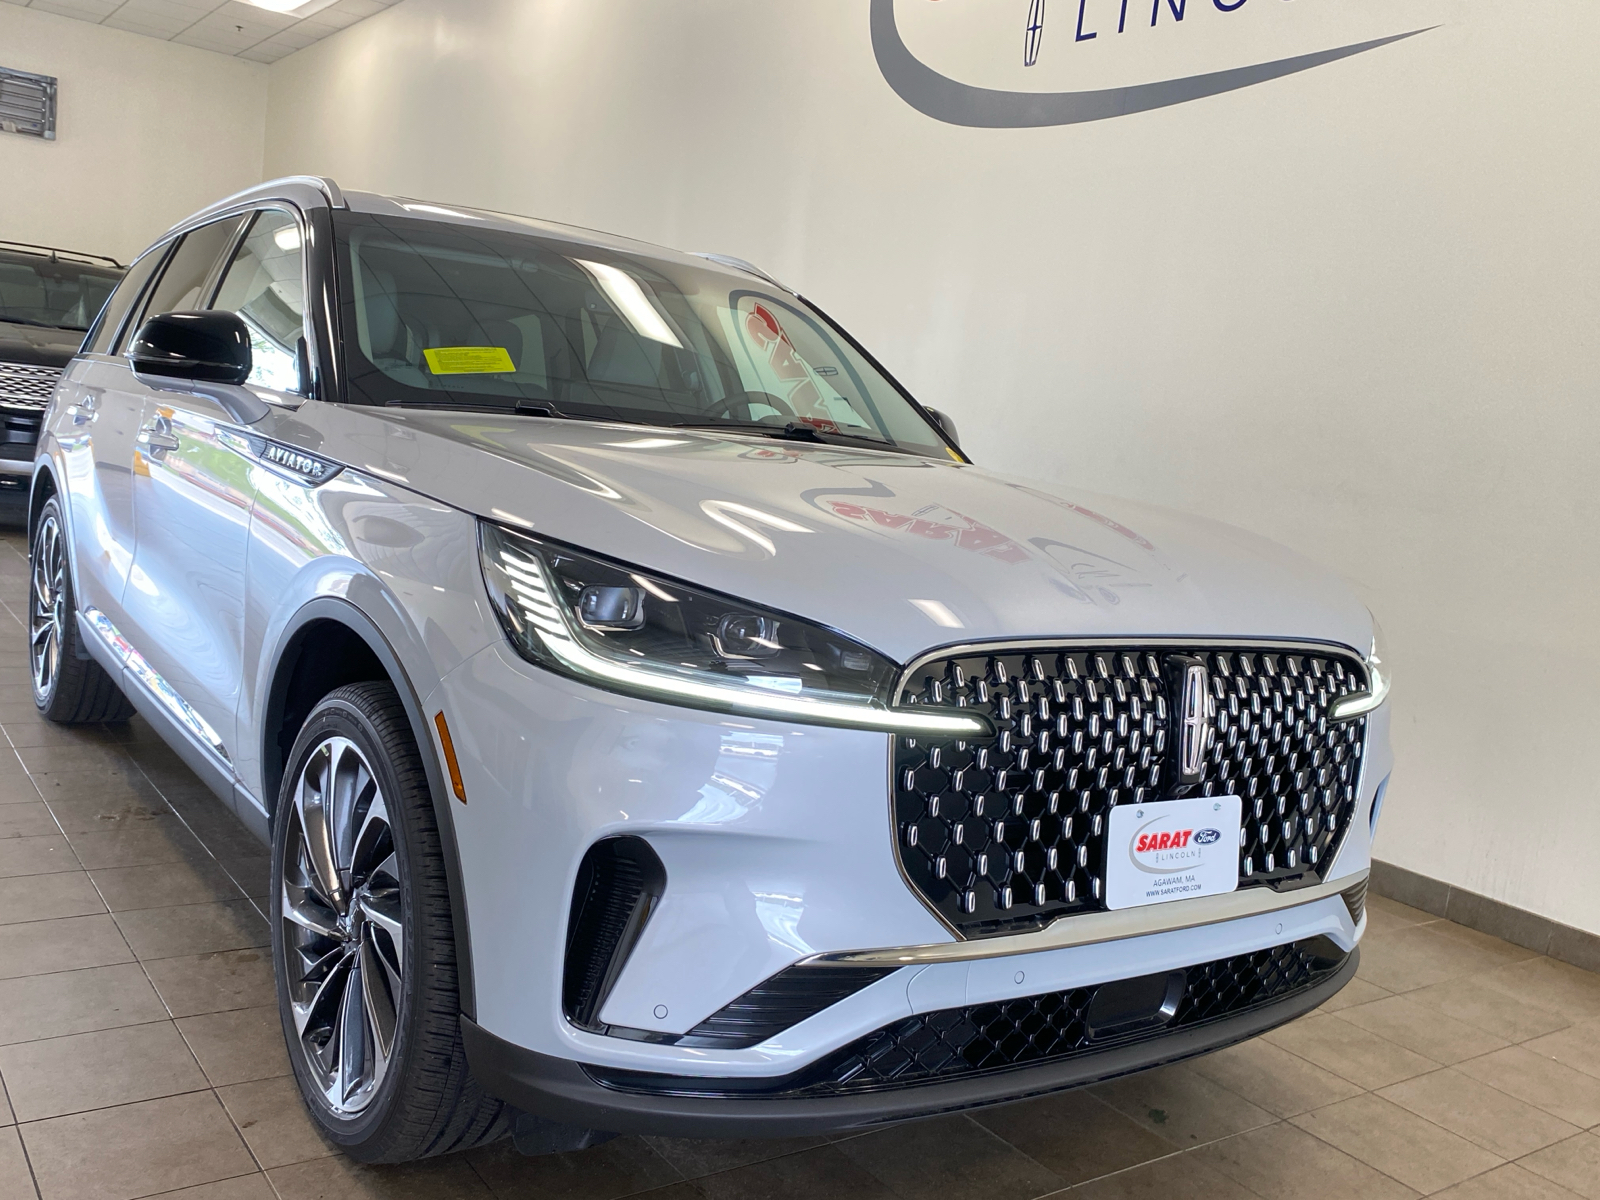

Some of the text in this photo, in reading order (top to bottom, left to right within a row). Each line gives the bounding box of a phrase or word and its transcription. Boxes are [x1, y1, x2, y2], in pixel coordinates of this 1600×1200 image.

[267, 446, 323, 476] AVIATOR
[1136, 829, 1218, 852] SARAT Ford
[1161, 851, 1195, 860] LINCOLN
[1153, 874, 1196, 887] AGAWAM, MA
